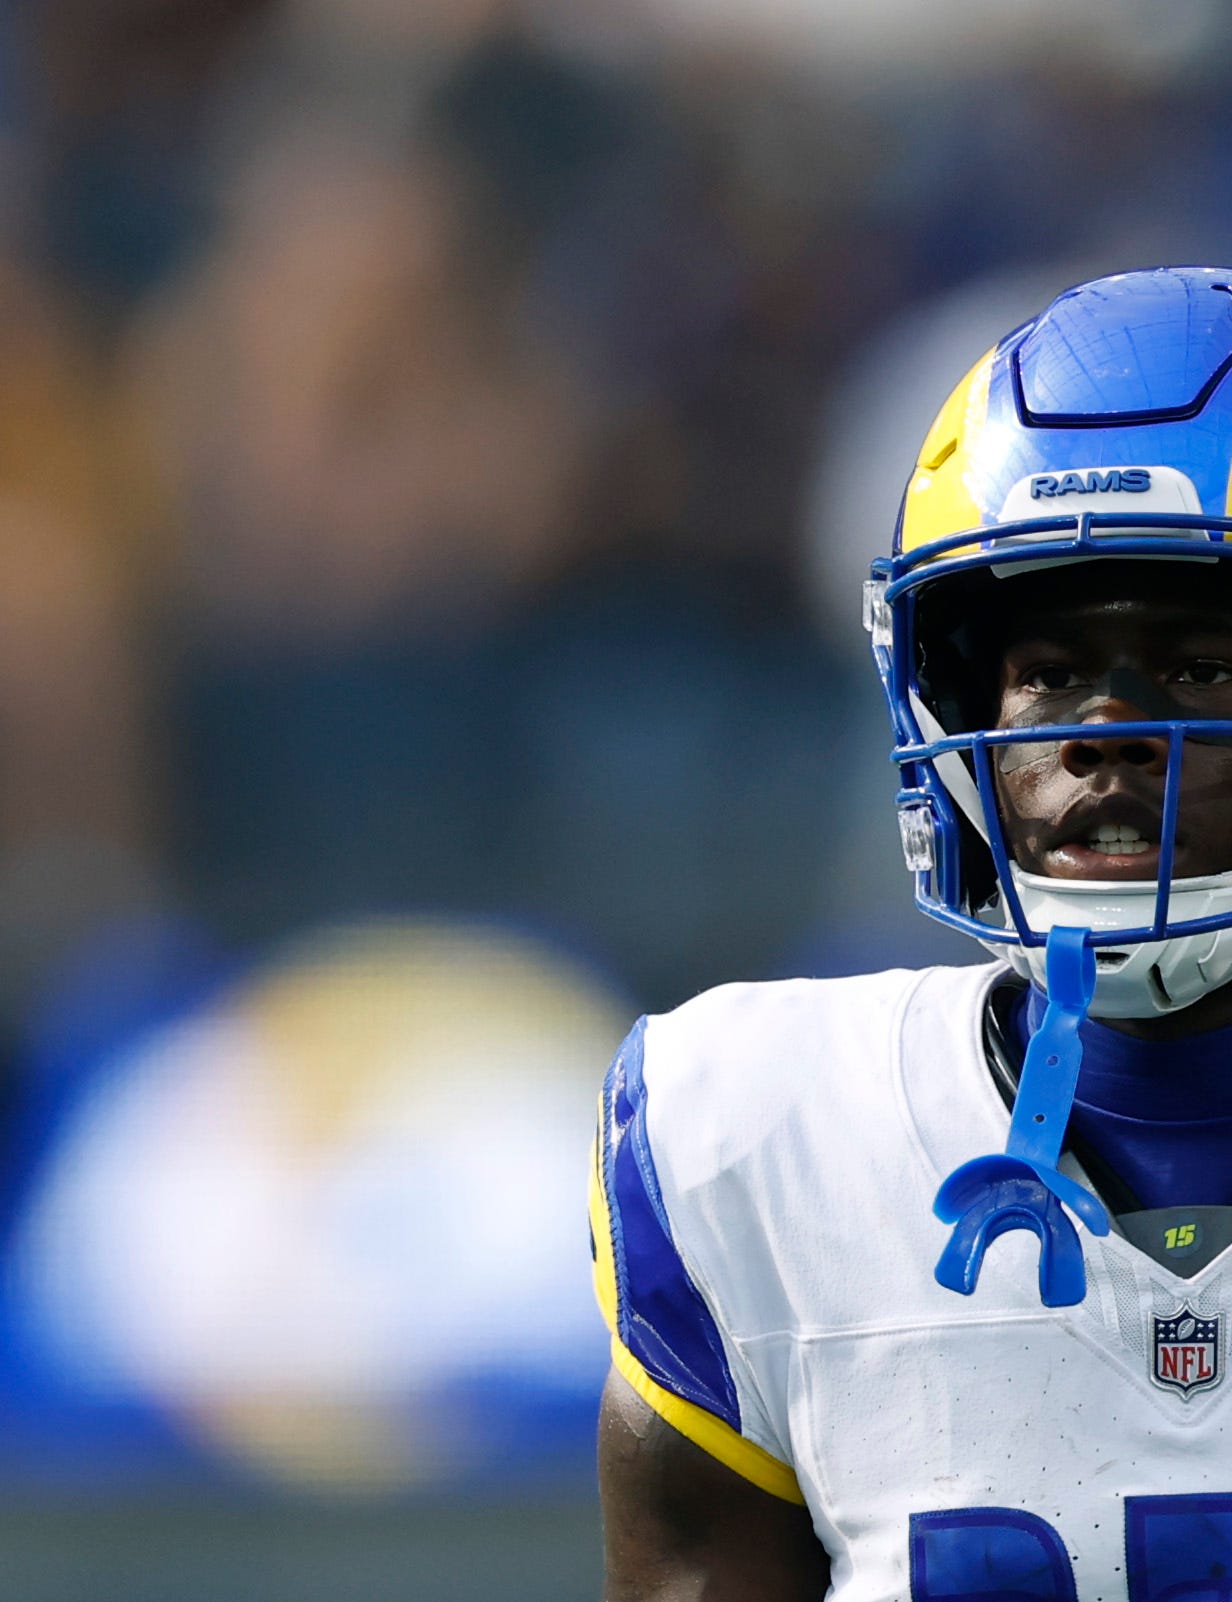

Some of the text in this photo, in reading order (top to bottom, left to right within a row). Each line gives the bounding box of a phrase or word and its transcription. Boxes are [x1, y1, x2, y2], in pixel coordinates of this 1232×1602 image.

[1031, 469, 1151, 499] RAMS
[1164, 1224, 1196, 1249] 15
[1160, 1346, 1212, 1382] NFL
